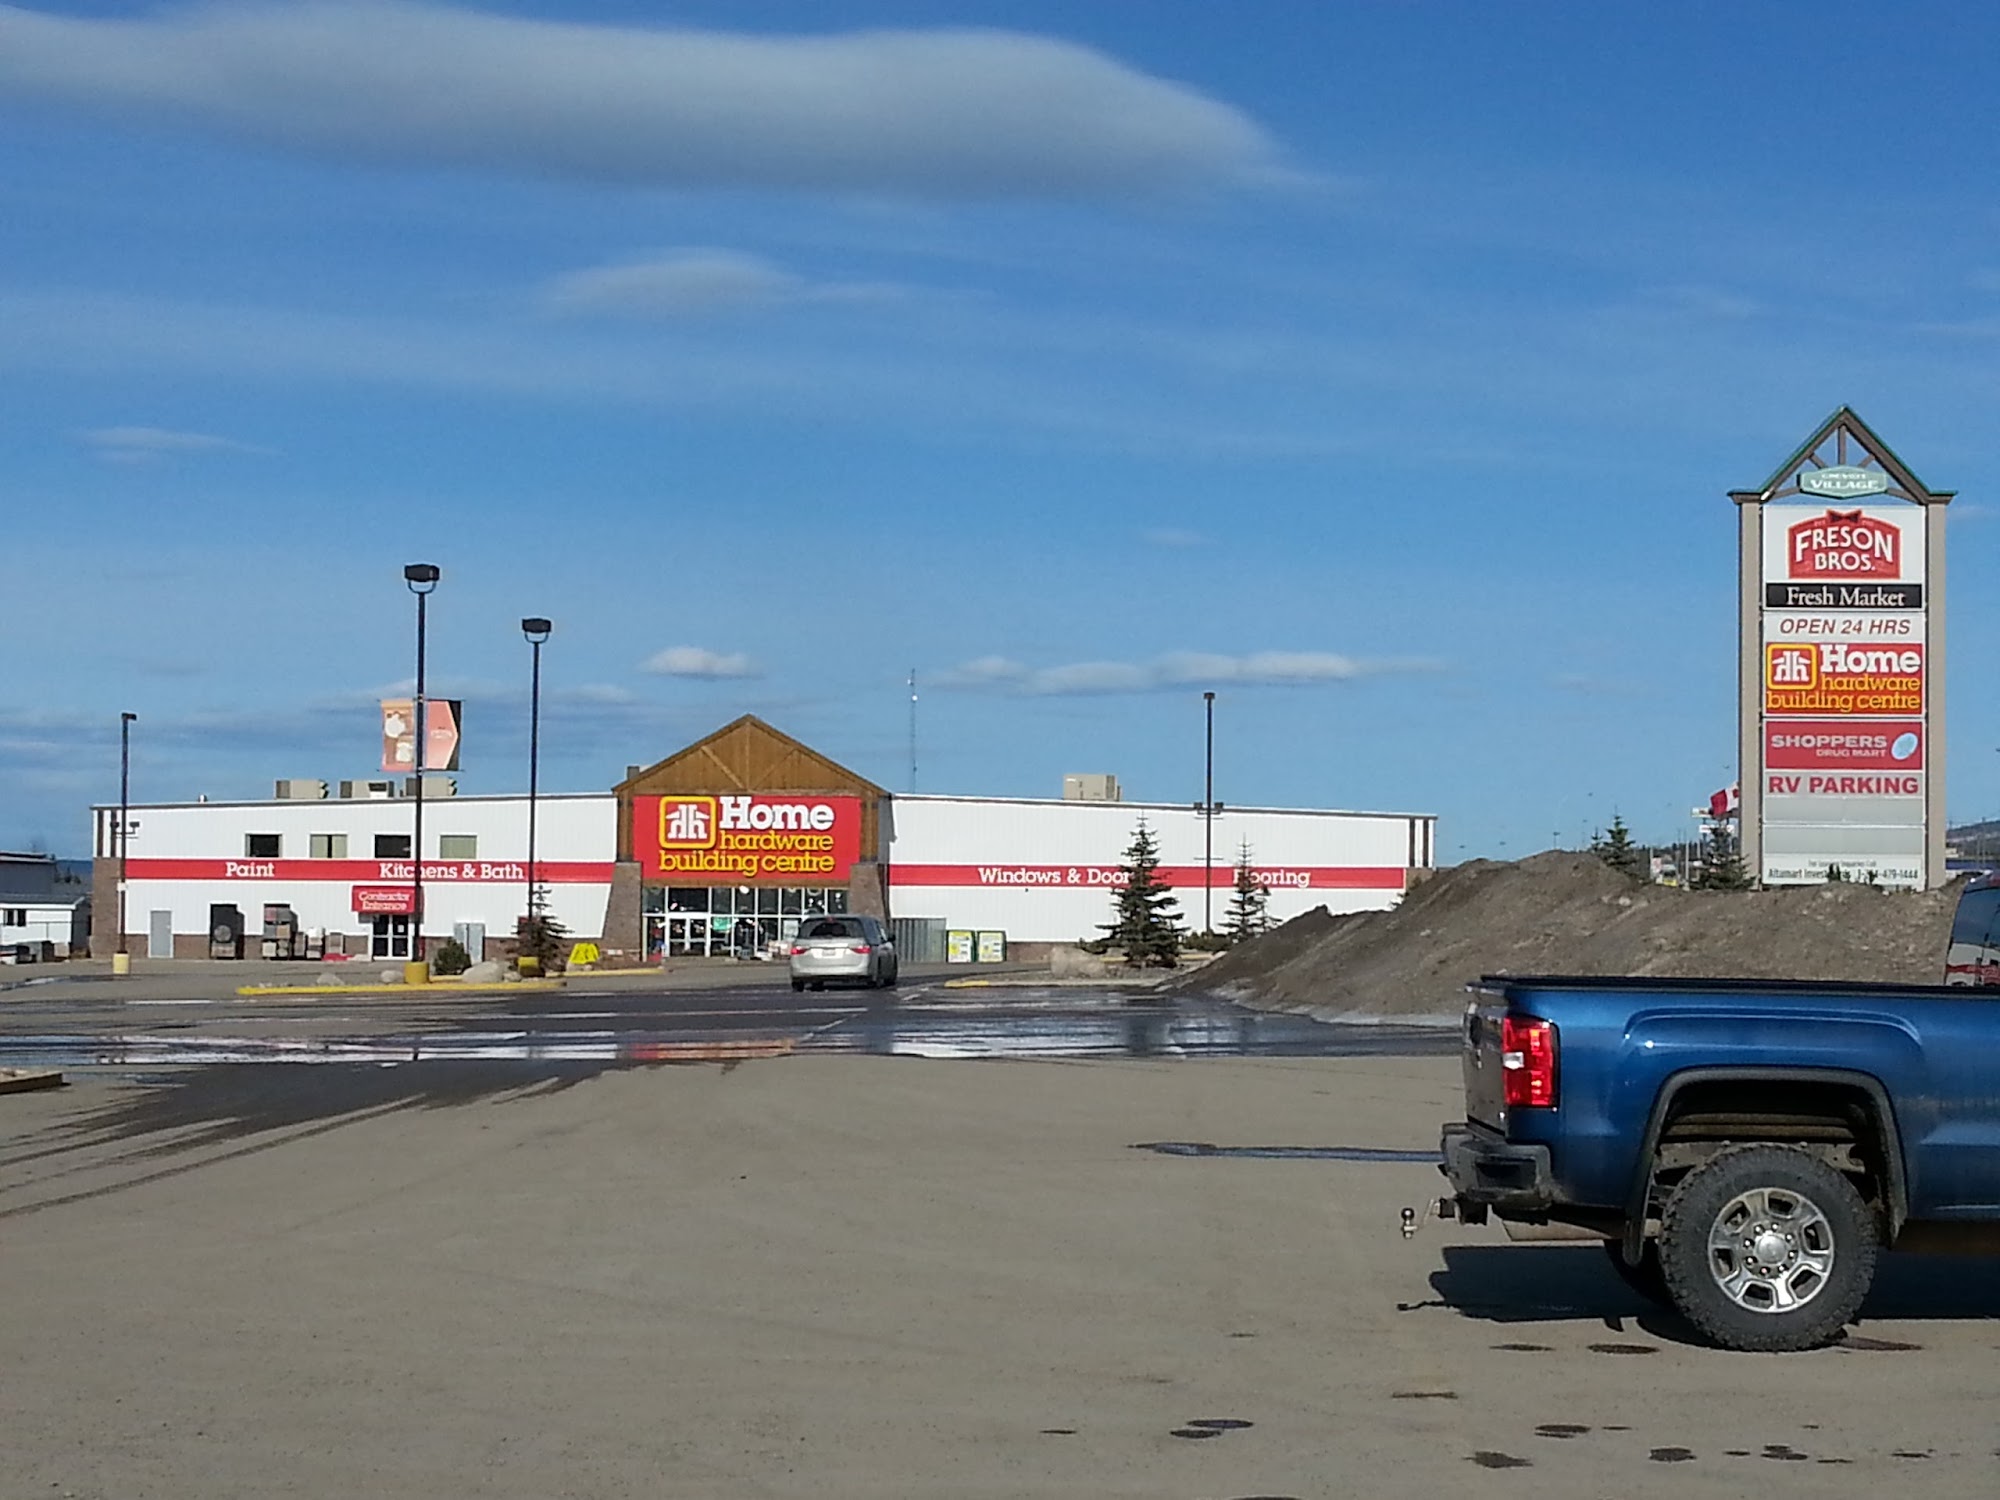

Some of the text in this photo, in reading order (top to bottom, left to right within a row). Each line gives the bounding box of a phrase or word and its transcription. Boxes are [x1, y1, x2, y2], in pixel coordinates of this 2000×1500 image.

[1810, 480, 1879, 490] VILLAGE
[1795, 526, 1893, 562] FRESON
[1814, 553, 1876, 571] BROS.
[1787, 586, 1905, 606] Fresh Market
[1780, 618, 1911, 635] OPEN 24 HRS
[1820, 644, 1921, 674] Home
[1821, 673, 1921, 691] hardware
[1766, 691, 1921, 712] building centre
[1771, 735, 1888, 748] SHOPPERS
[1816, 749, 1886, 757] DRUG MART
[1768, 776, 1919, 794] RV PARKING
[719, 796, 834, 830] Home
[719, 830, 835, 851] hardware
[225, 862, 275, 878] Paint
[462, 863, 476, 879] &
[480, 863, 525, 880] Bath
[659, 850, 835, 877] building centre
[978, 867, 1137, 884] Windows & Door
